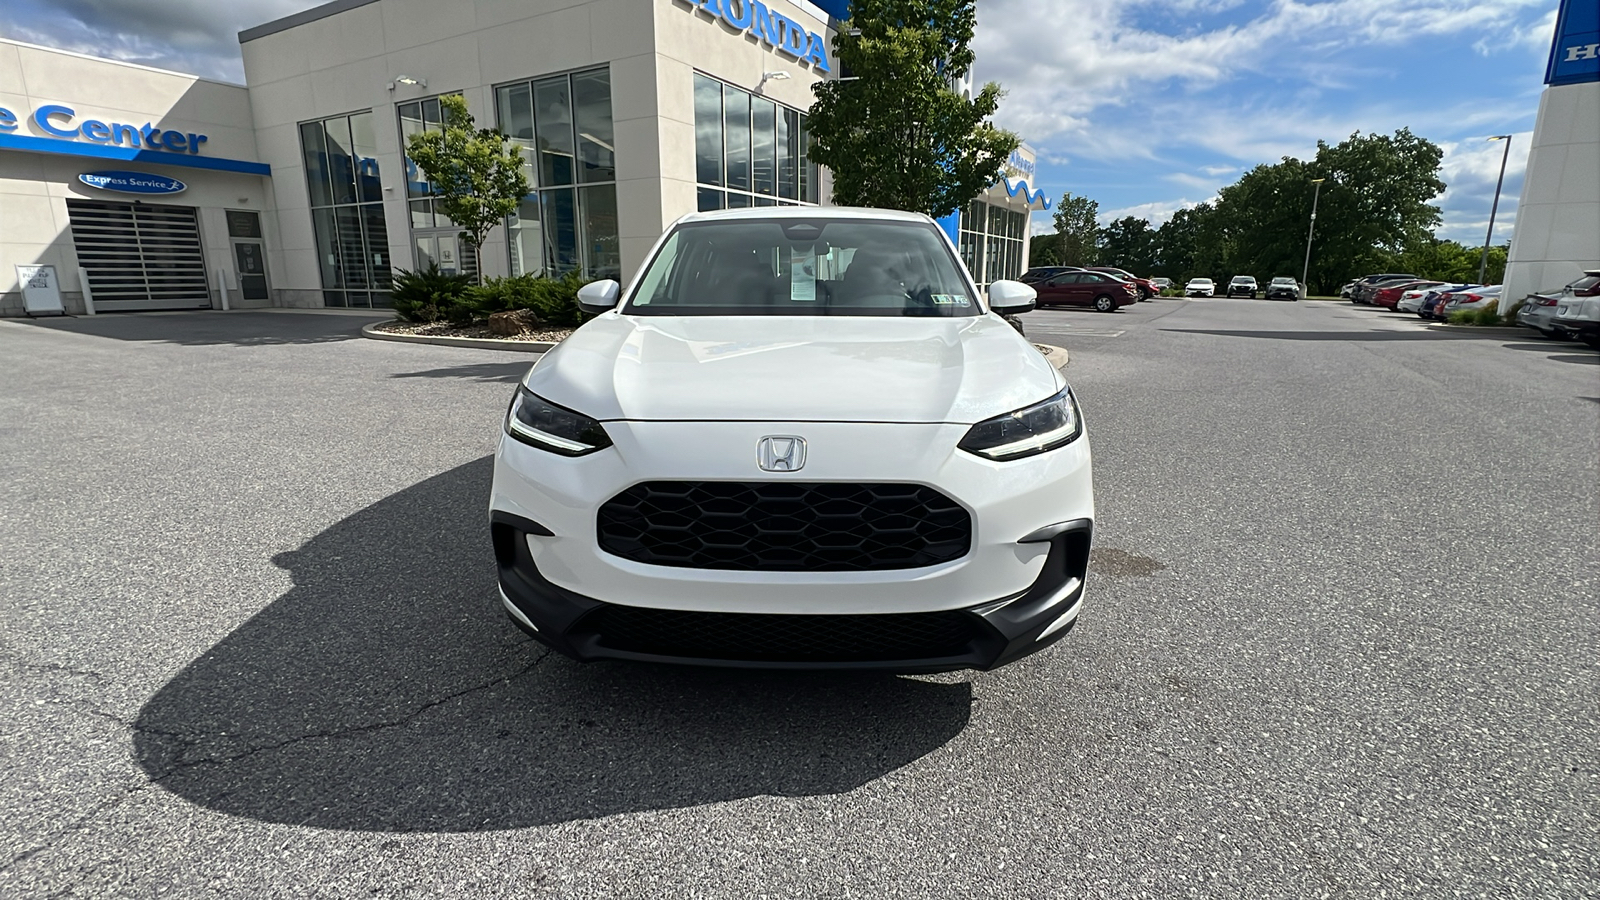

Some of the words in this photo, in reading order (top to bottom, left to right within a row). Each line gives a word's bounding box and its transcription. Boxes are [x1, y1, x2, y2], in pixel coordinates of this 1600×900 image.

[1564, 43, 1600, 62] H
[34, 104, 208, 154] Center
[86, 174, 127, 186] Express
[129, 178, 167, 189] Service
